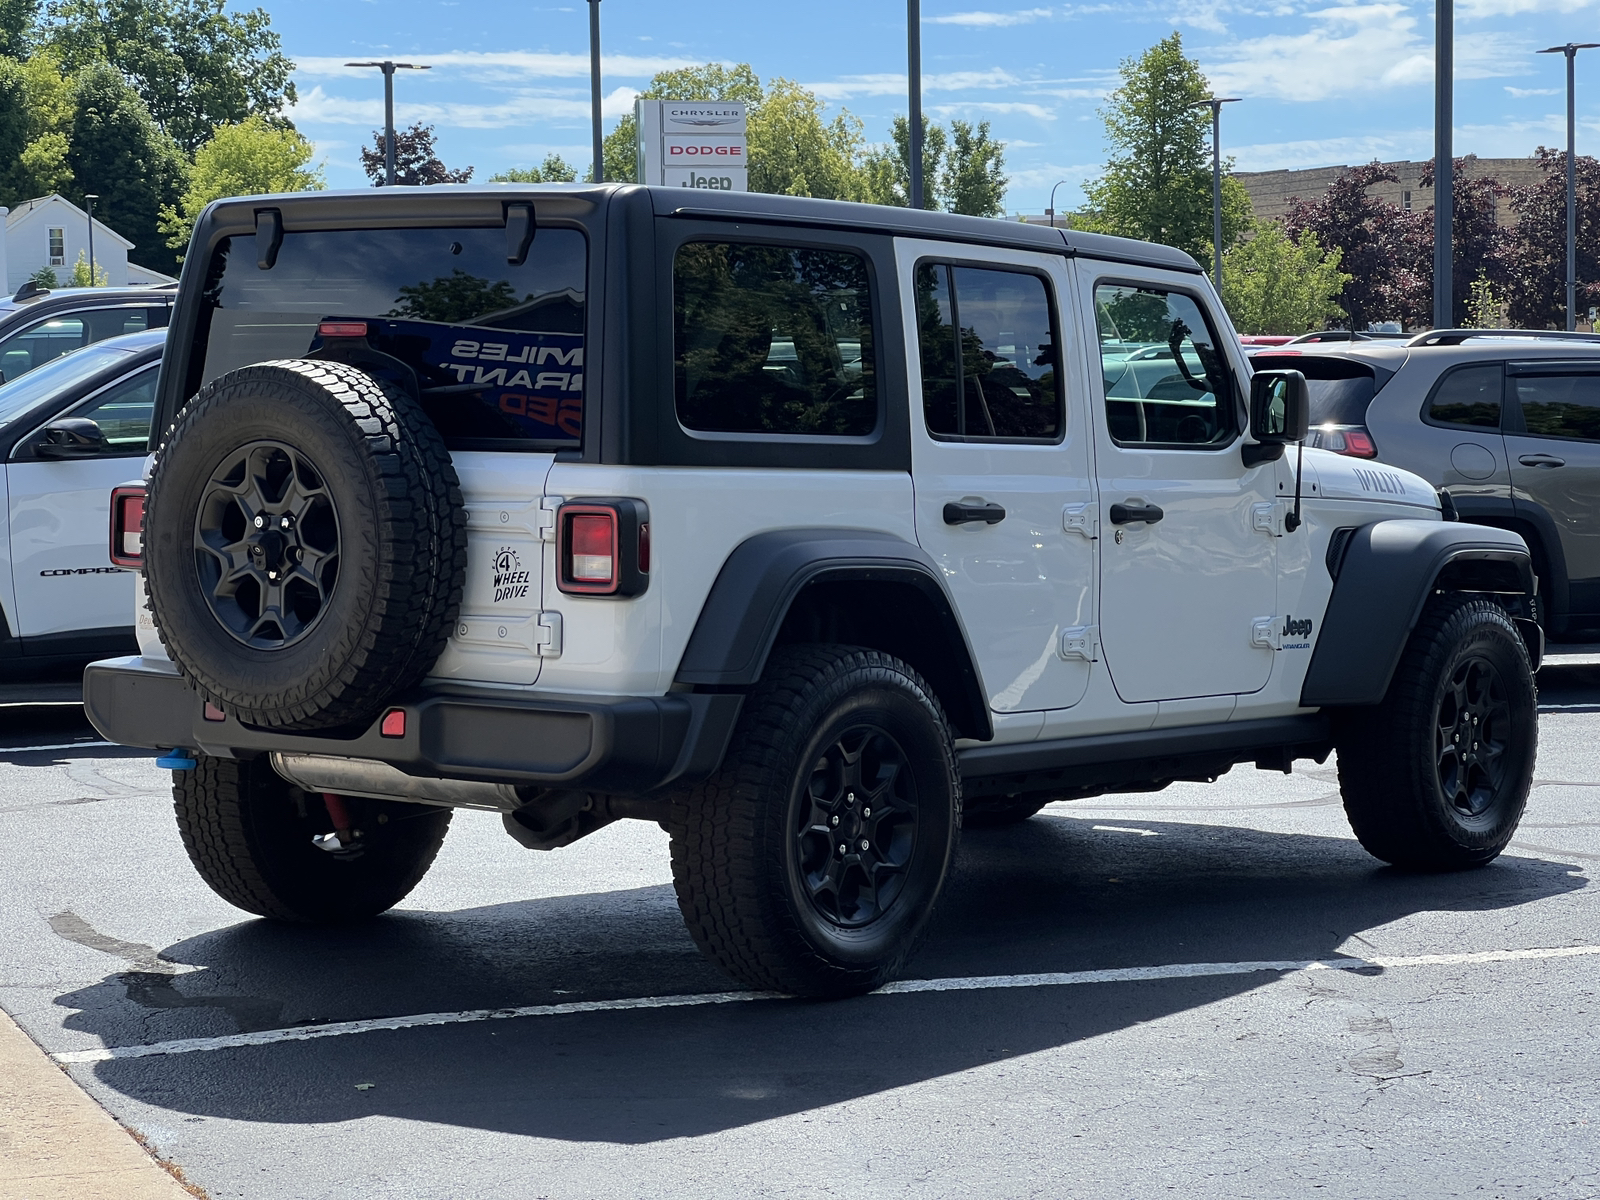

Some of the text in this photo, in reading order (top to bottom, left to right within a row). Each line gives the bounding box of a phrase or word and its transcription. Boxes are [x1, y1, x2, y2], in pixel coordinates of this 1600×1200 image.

[670, 146, 742, 156] DODGE
[682, 172, 732, 191] Jeep
[1352, 468, 1406, 496] WILLYS
[40, 567, 134, 577] COMPAS
[499, 554, 510, 572] 4
[493, 571, 530, 588] WHEEL
[494, 585, 529, 603] DRIVE
[1282, 614, 1313, 640] Jeep
